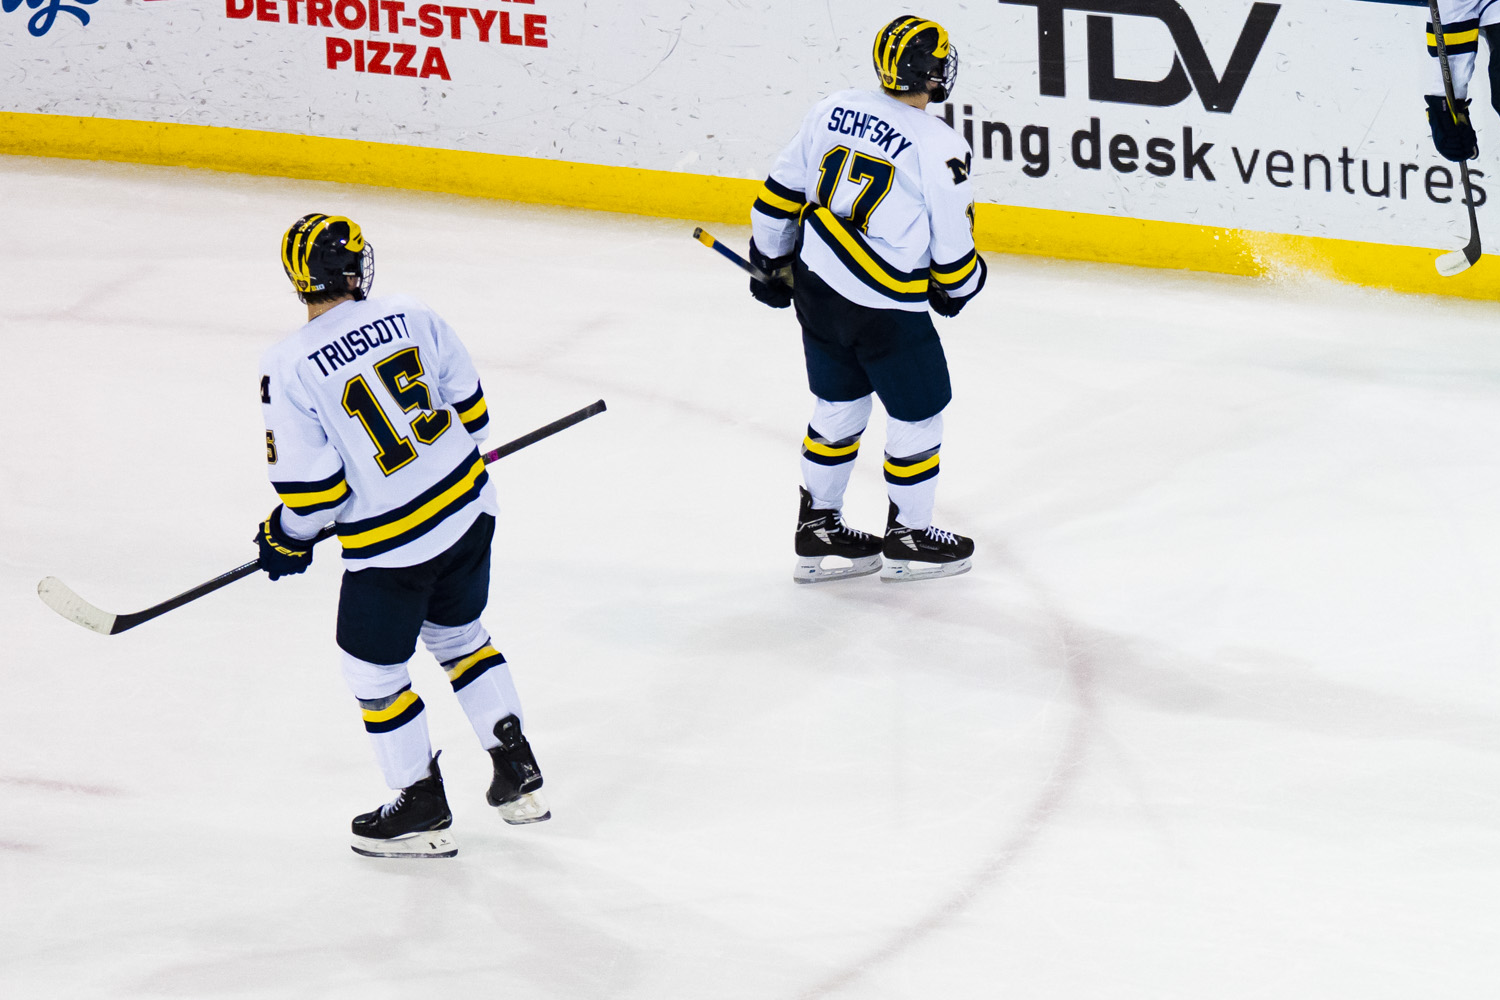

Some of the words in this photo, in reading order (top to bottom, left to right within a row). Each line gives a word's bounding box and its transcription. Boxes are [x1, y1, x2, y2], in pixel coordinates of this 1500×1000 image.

[325, 36, 452, 82] PIZZA
[816, 144, 896, 236] 17
[1071, 117, 1217, 182] desk
[1231, 146, 1488, 208] ventures
[308, 313, 411, 378] TRUSCOTT
[342, 347, 453, 478] 15
